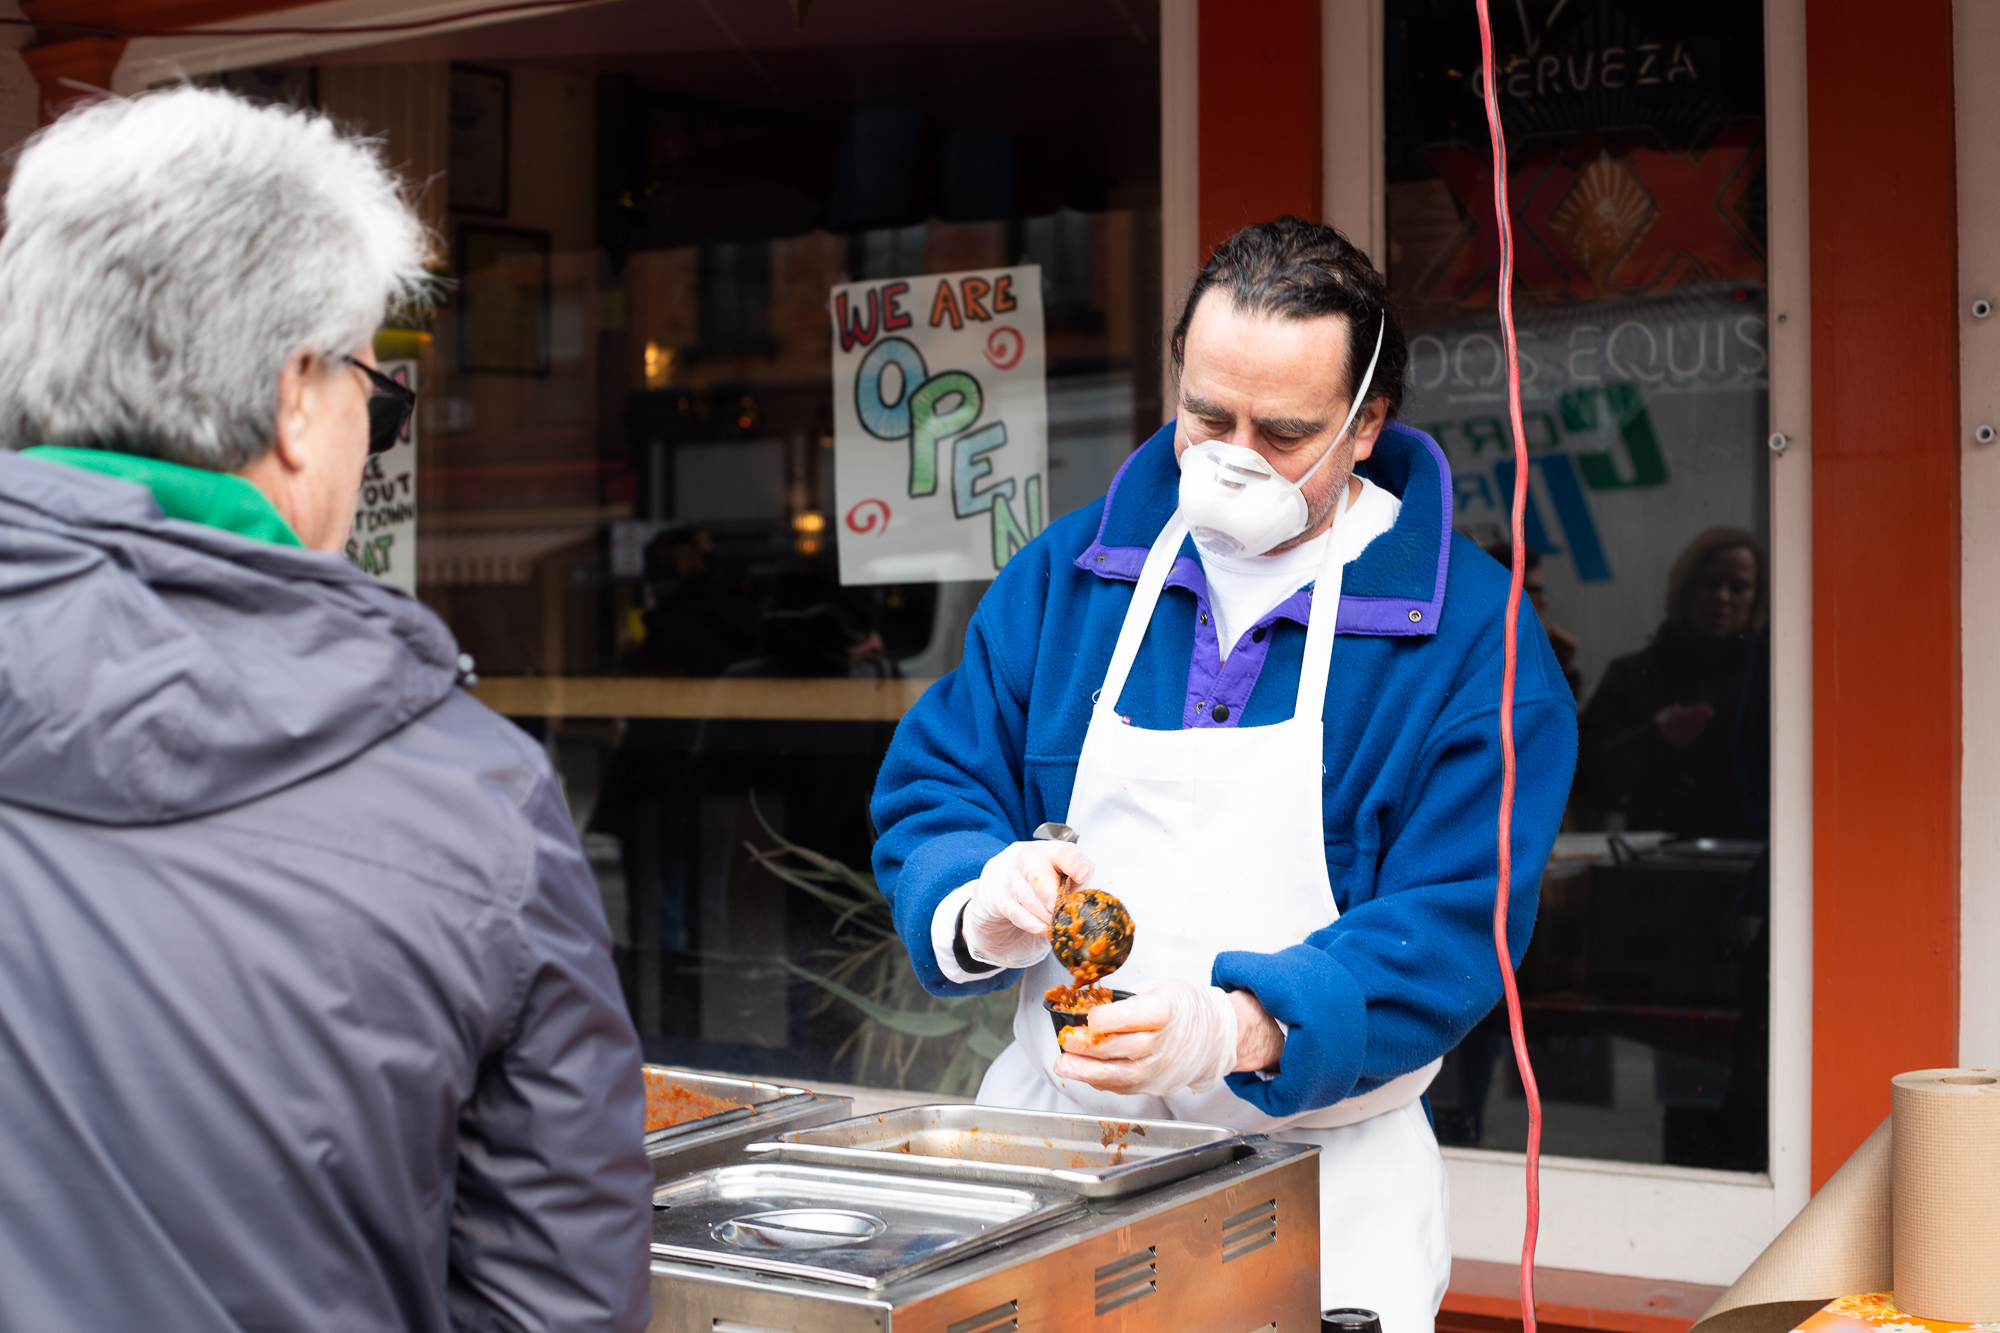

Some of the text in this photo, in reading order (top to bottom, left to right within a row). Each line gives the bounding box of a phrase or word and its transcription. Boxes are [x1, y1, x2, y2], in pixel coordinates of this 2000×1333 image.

[1470, 40, 1699, 101] CERVEZA
[837, 274, 1017, 353] WE ARE
[1408, 315, 1766, 390] DOS EQUIS
[855, 336, 1042, 572] OPEN
[363, 472, 410, 506] OUT
[345, 534, 394, 577] SAT
